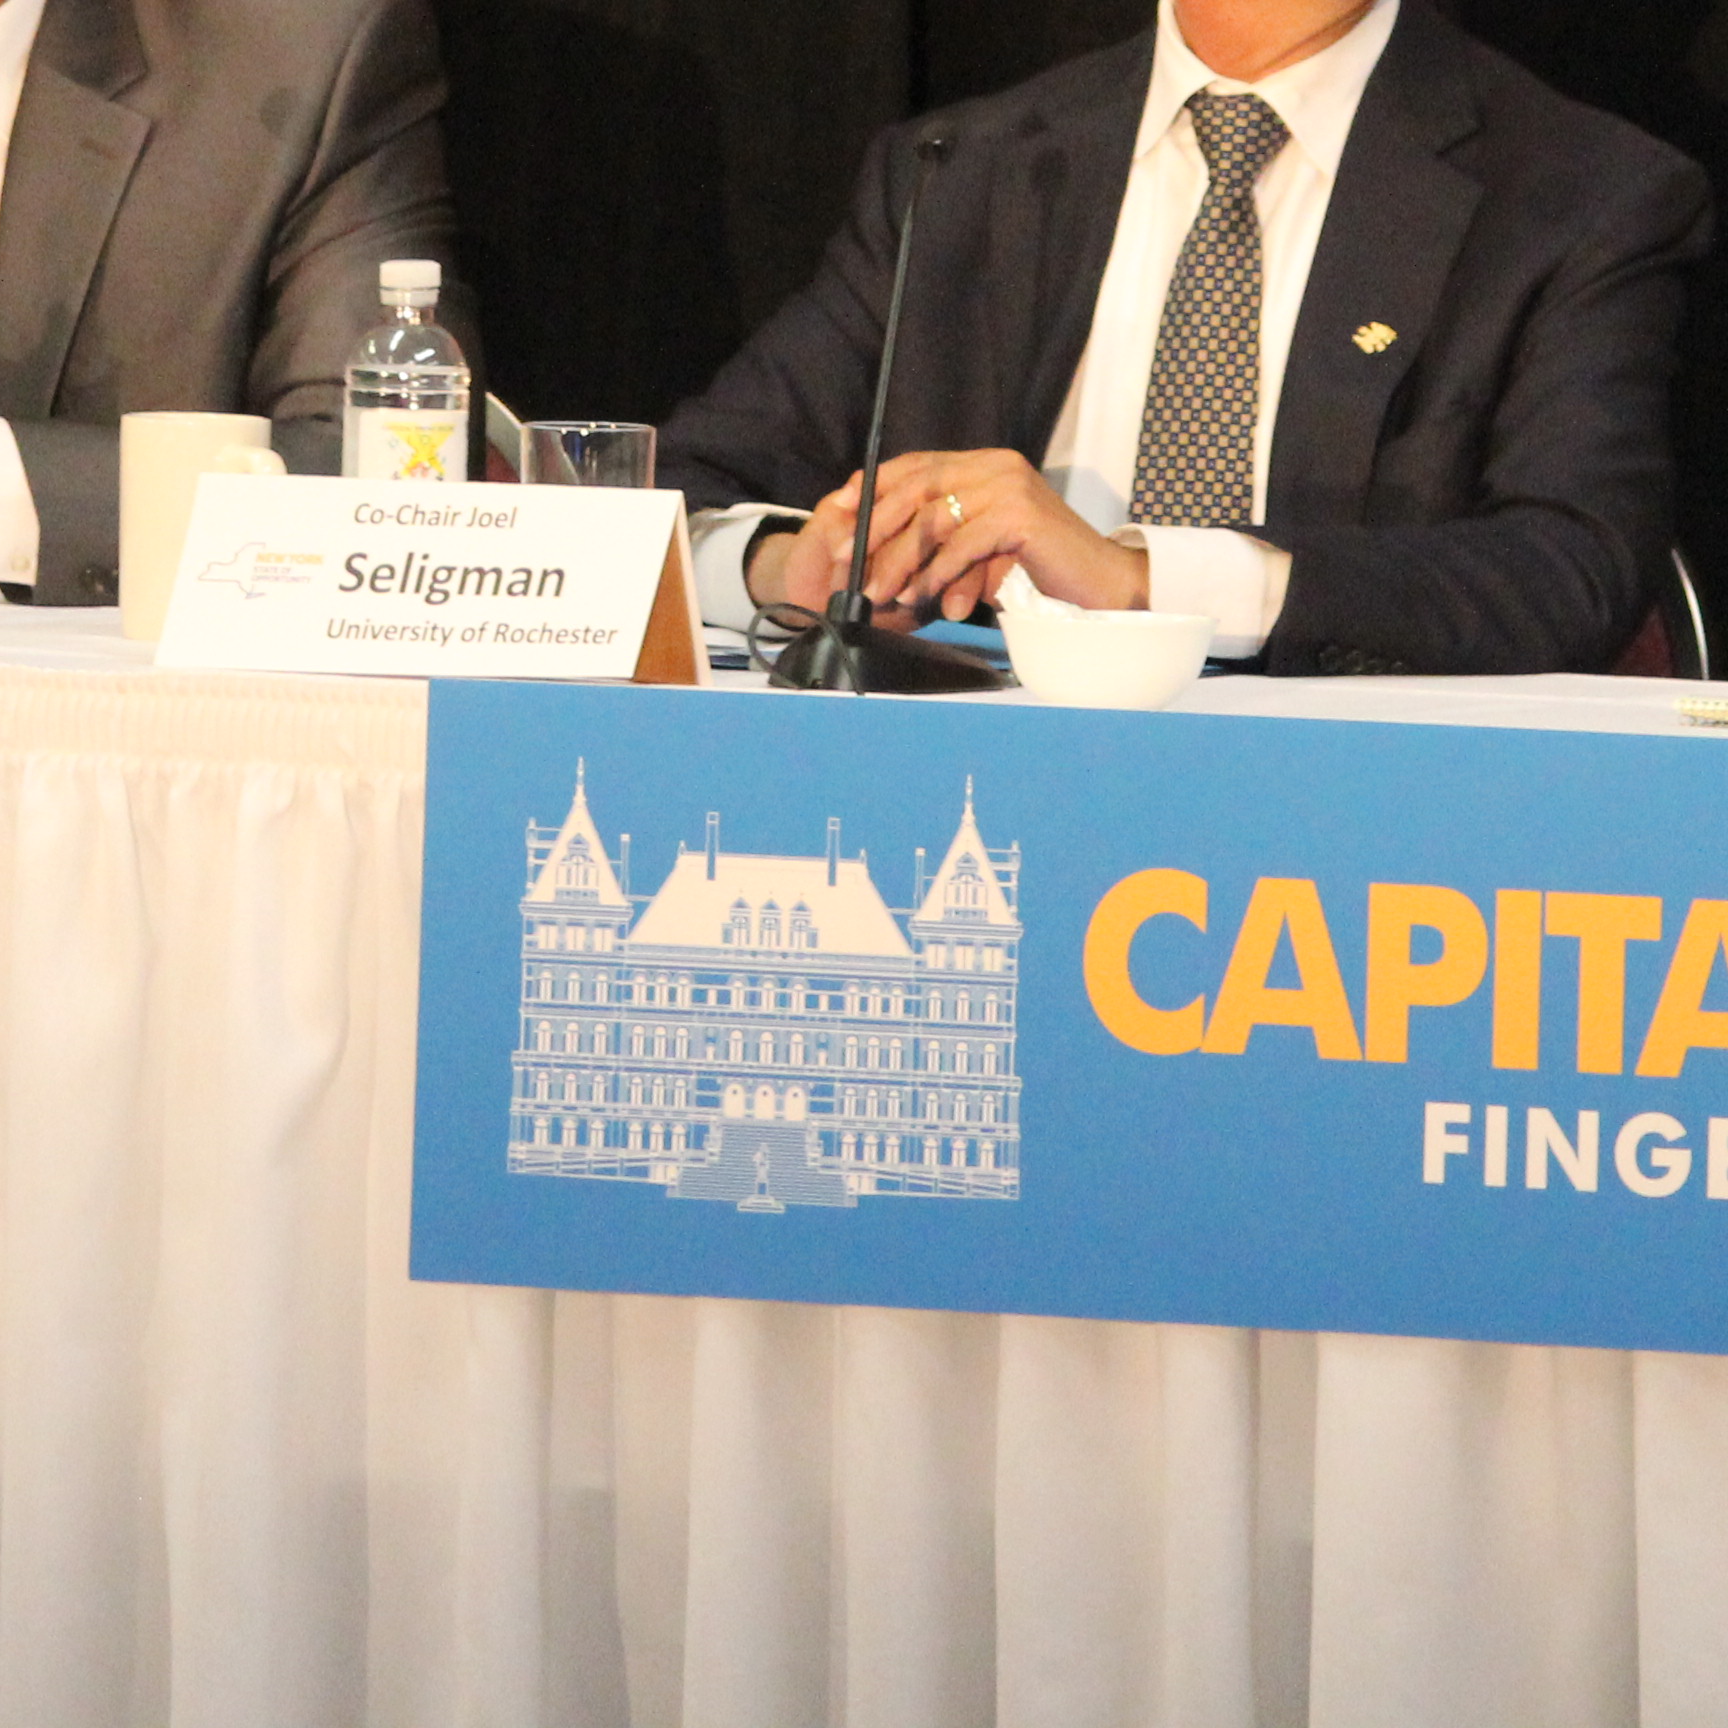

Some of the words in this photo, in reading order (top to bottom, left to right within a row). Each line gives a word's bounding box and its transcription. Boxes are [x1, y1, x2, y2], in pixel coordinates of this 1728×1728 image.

[354, 503, 461, 526] Co-Chair
[466, 507, 517, 528] Joel
[339, 552, 565, 605] Seligman
[327, 619, 454, 647] University
[461, 622, 489, 642] of
[494, 622, 617, 644] Rochester
